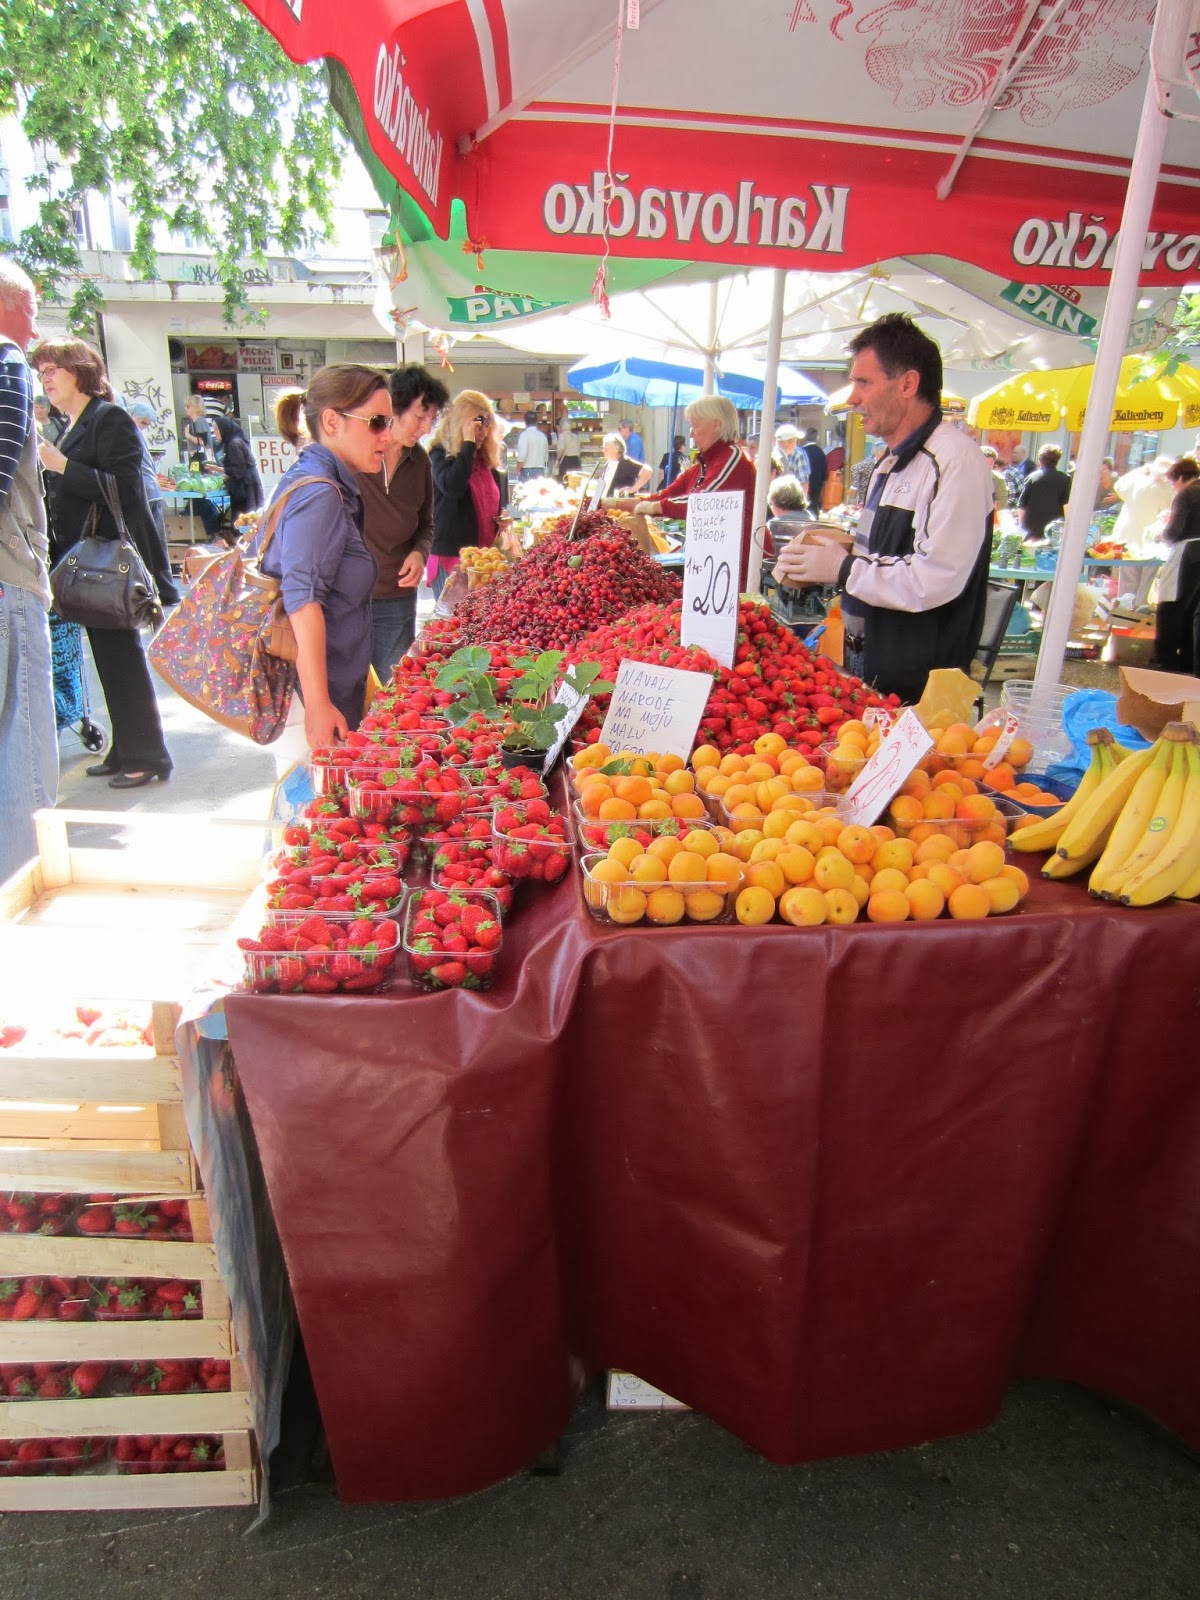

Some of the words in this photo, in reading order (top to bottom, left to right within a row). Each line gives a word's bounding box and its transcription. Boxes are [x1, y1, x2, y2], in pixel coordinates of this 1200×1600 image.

[1014, 283, 1084, 334] PAN
[263, 377, 296, 385] CHICKEN
[1113, 409, 1164, 424] Kaltenberg
[620, 669, 673, 691] NAVALI
[614, 706, 631, 719] NA
[609, 722, 646, 740] MALU
